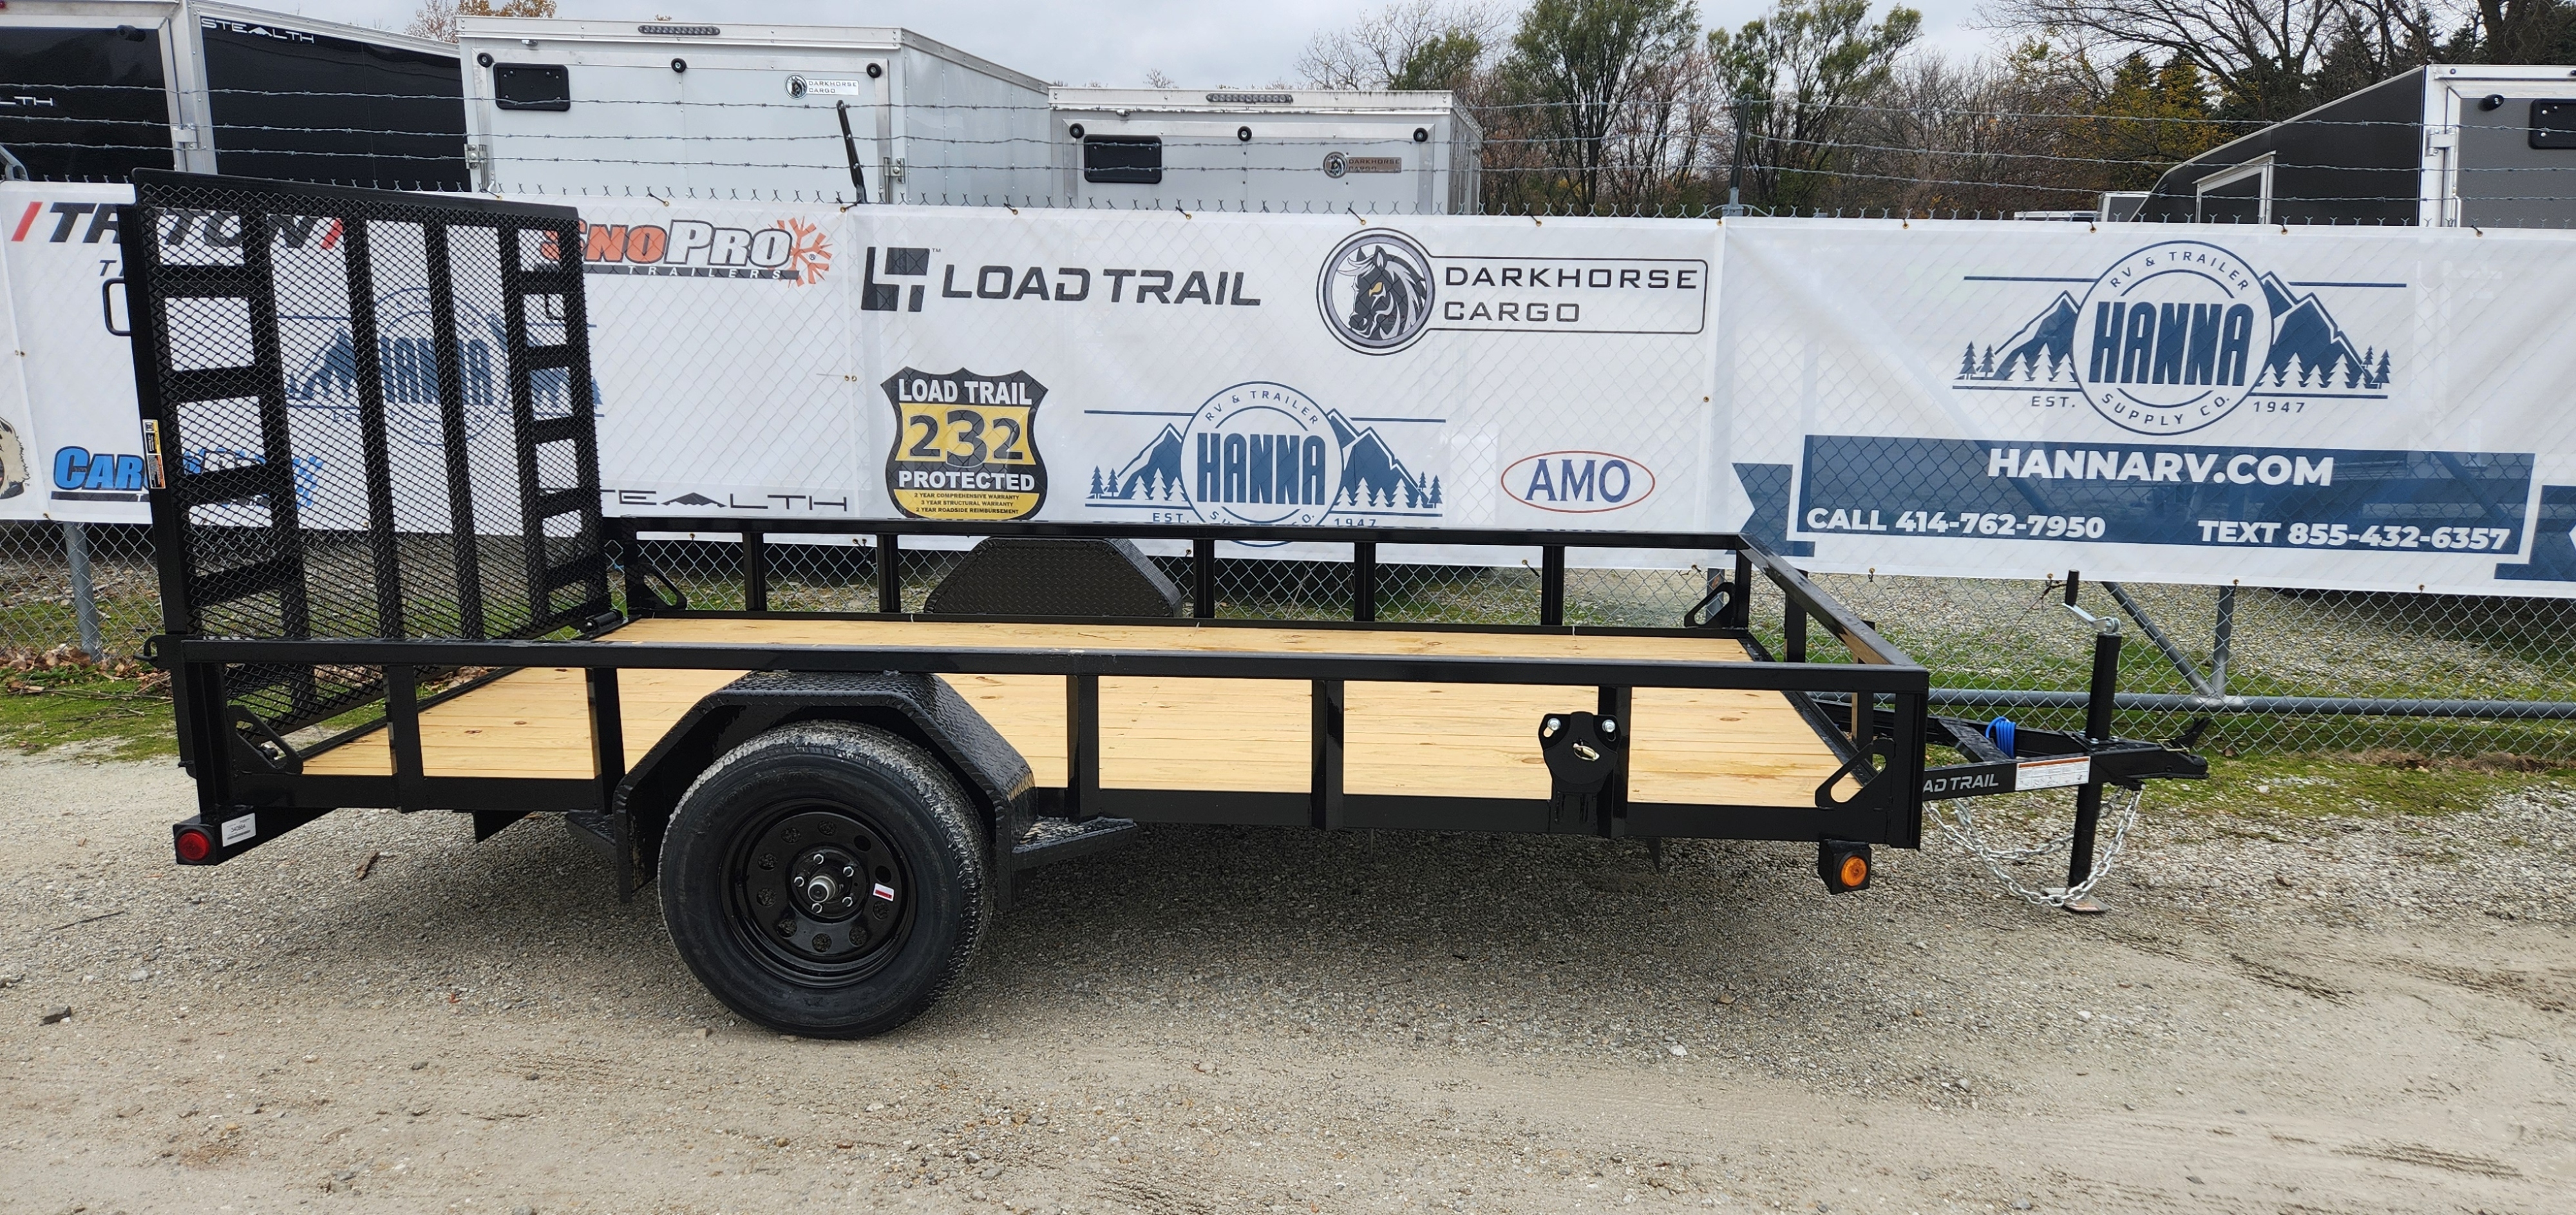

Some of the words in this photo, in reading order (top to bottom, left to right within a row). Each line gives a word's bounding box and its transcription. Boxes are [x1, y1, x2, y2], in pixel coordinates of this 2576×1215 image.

[201, 17, 314, 44] STEALTH
[629, 265, 781, 279] TRAILERS
[942, 264, 1091, 301] LOAD
[1103, 269, 1261, 306] TRAIL
[1445, 267, 1698, 289] DARKHORSE
[2110, 267, 2132, 288] RV
[2146, 257, 2155, 266] &
[2169, 251, 2248, 290] TRAILER
[1444, 301, 1580, 323] CARGO
[2088, 301, 2254, 386] HANNA
[899, 379, 958, 402] LOAD
[965, 381, 1032, 405] TRAIL
[1205, 403, 1222, 421] RV
[1231, 395, 1240, 403] &
[1250, 390, 1318, 424] TRAILER
[2032, 396, 2075, 408] EST.
[2254, 401, 2305, 413] 1947
[2102, 393, 2183, 425] SUPPLY
[2200, 396, 2230, 416] CO.
[909, 409, 1024, 468] 232
[898, 470, 1035, 491] PROTECTED
[1197, 433, 1325, 505] HANNA
[1524, 459, 1631, 502] AMO
[1988, 448, 2334, 486] HANNARV.COM
[1807, 508, 1887, 531] CALL
[1896, 511, 2105, 539] 414-762-7950
[2198, 520, 2281, 543] TEXT
[2287, 522, 2510, 550] 855-432-6357
[1923, 778, 1947, 792] AD
[1950, 773, 1999, 790] TRAIL
